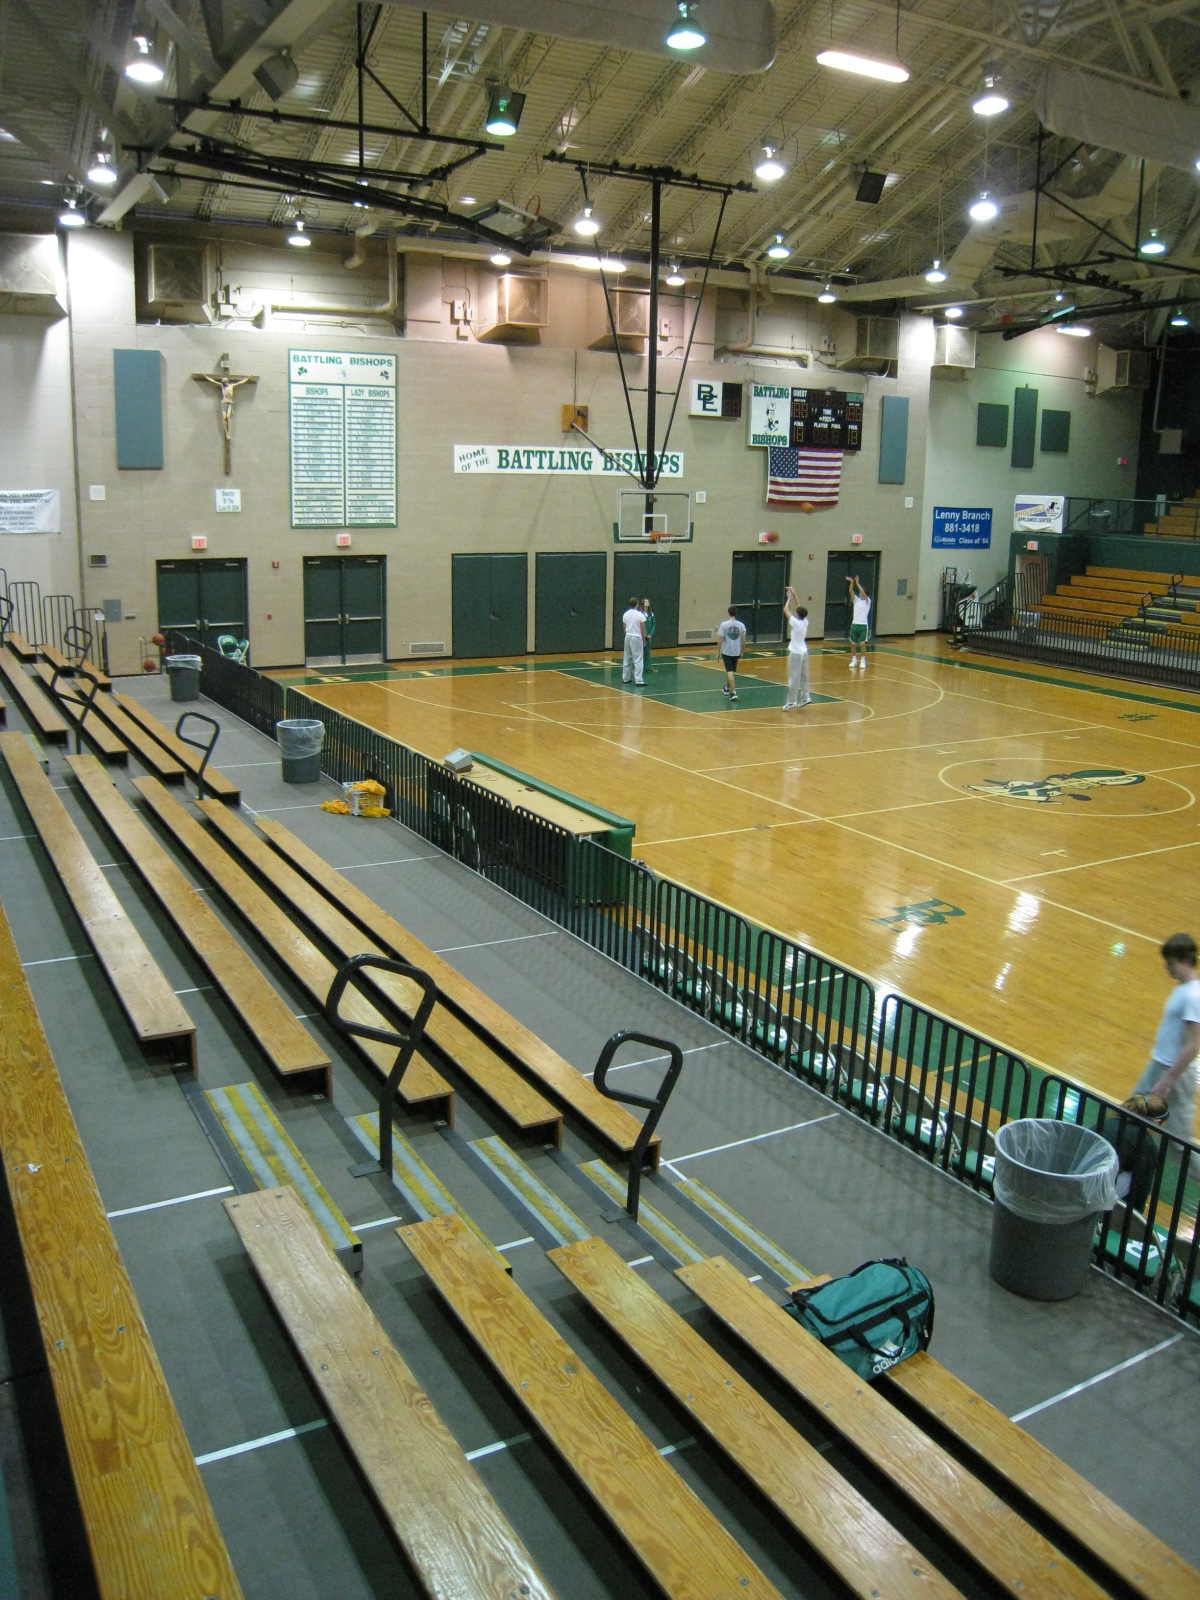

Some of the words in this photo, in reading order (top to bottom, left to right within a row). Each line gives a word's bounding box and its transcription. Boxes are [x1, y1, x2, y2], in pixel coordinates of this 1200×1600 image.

[292, 354, 343, 365] BATTLING
[349, 357, 393, 367] BISHOPS
[305, 387, 329, 396] BISHOPS
[351, 388, 365, 397] LADY
[368, 389, 391, 398] BISHOPS
[753, 385, 789, 399] BATTLING
[793, 389, 807, 398] GUEST
[752, 433, 788, 446] BISHOPS
[458, 447, 488, 463] HOME
[496, 449, 593, 471] BATTLING
[461, 462, 473, 472] OF
[474, 457, 491, 469] THE
[935, 509, 960, 522] Lenny
[962, 510, 990, 520] Branch
[1015, 504, 1047, 517] WHOLESALE
[944, 523, 980, 533] 881-3418
[872, 1347, 906, 1374] adid
